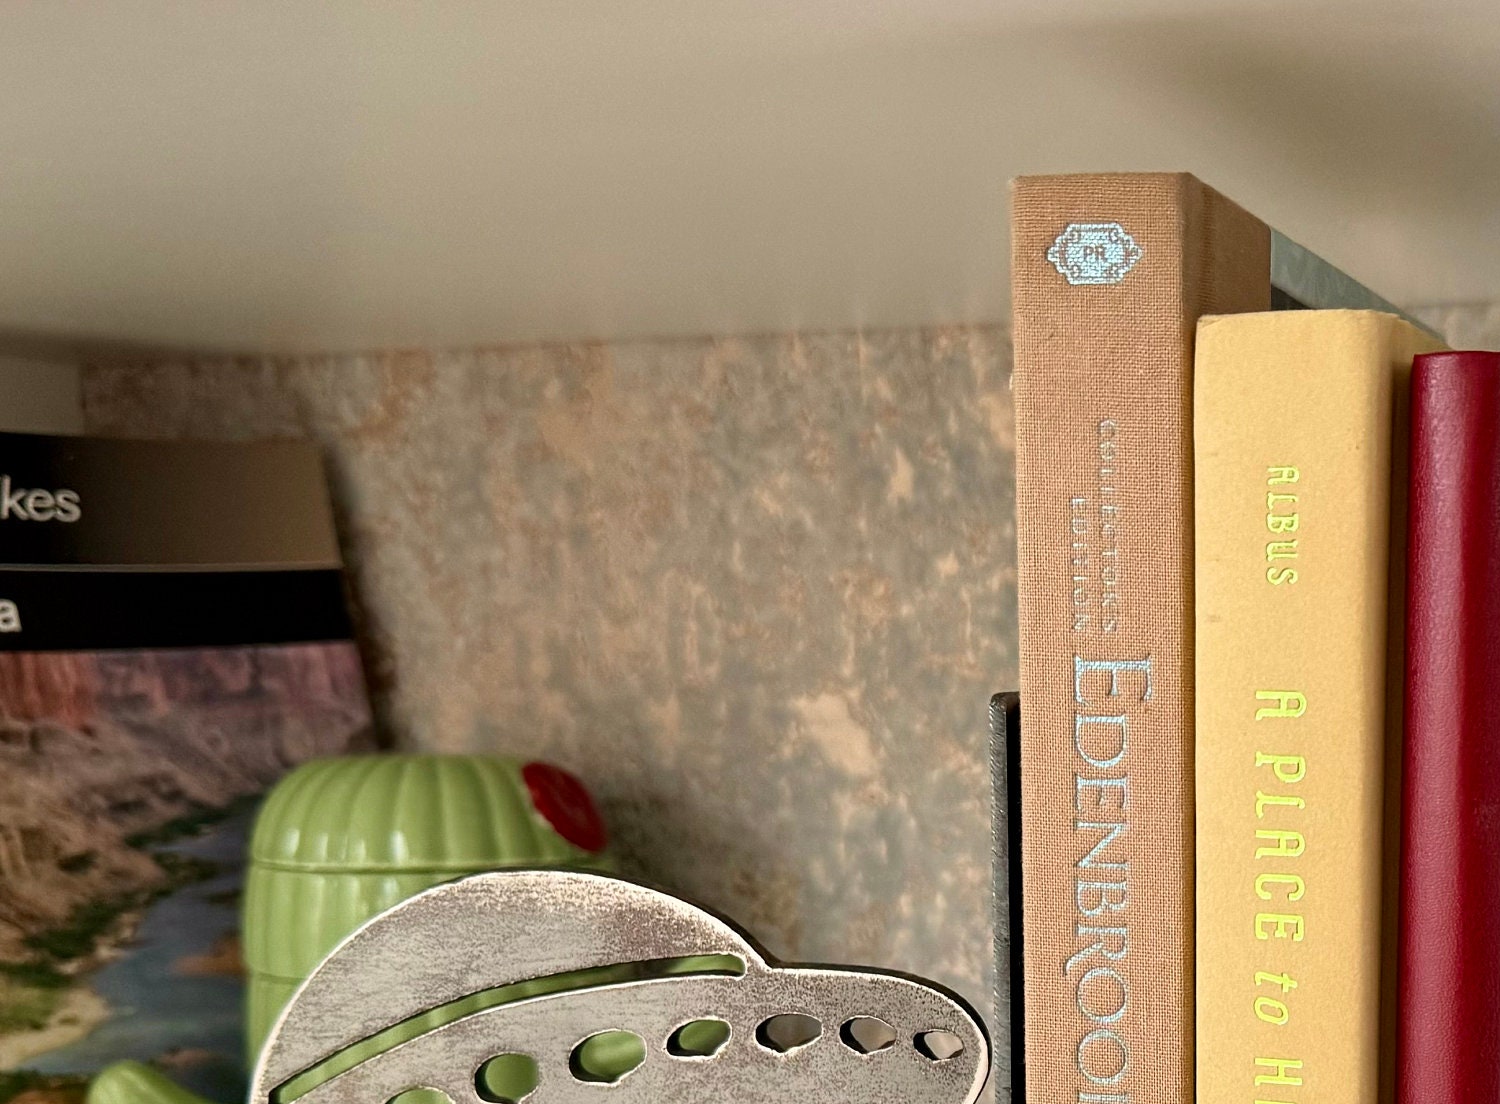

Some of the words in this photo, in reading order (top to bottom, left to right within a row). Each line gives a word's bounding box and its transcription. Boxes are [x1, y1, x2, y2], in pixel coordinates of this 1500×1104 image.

[1266, 465, 1300, 585] ALBUS
[1255, 689, 1308, 721] A
[1254, 751, 1306, 942] PLACE
[1253, 971, 1298, 1026] to
